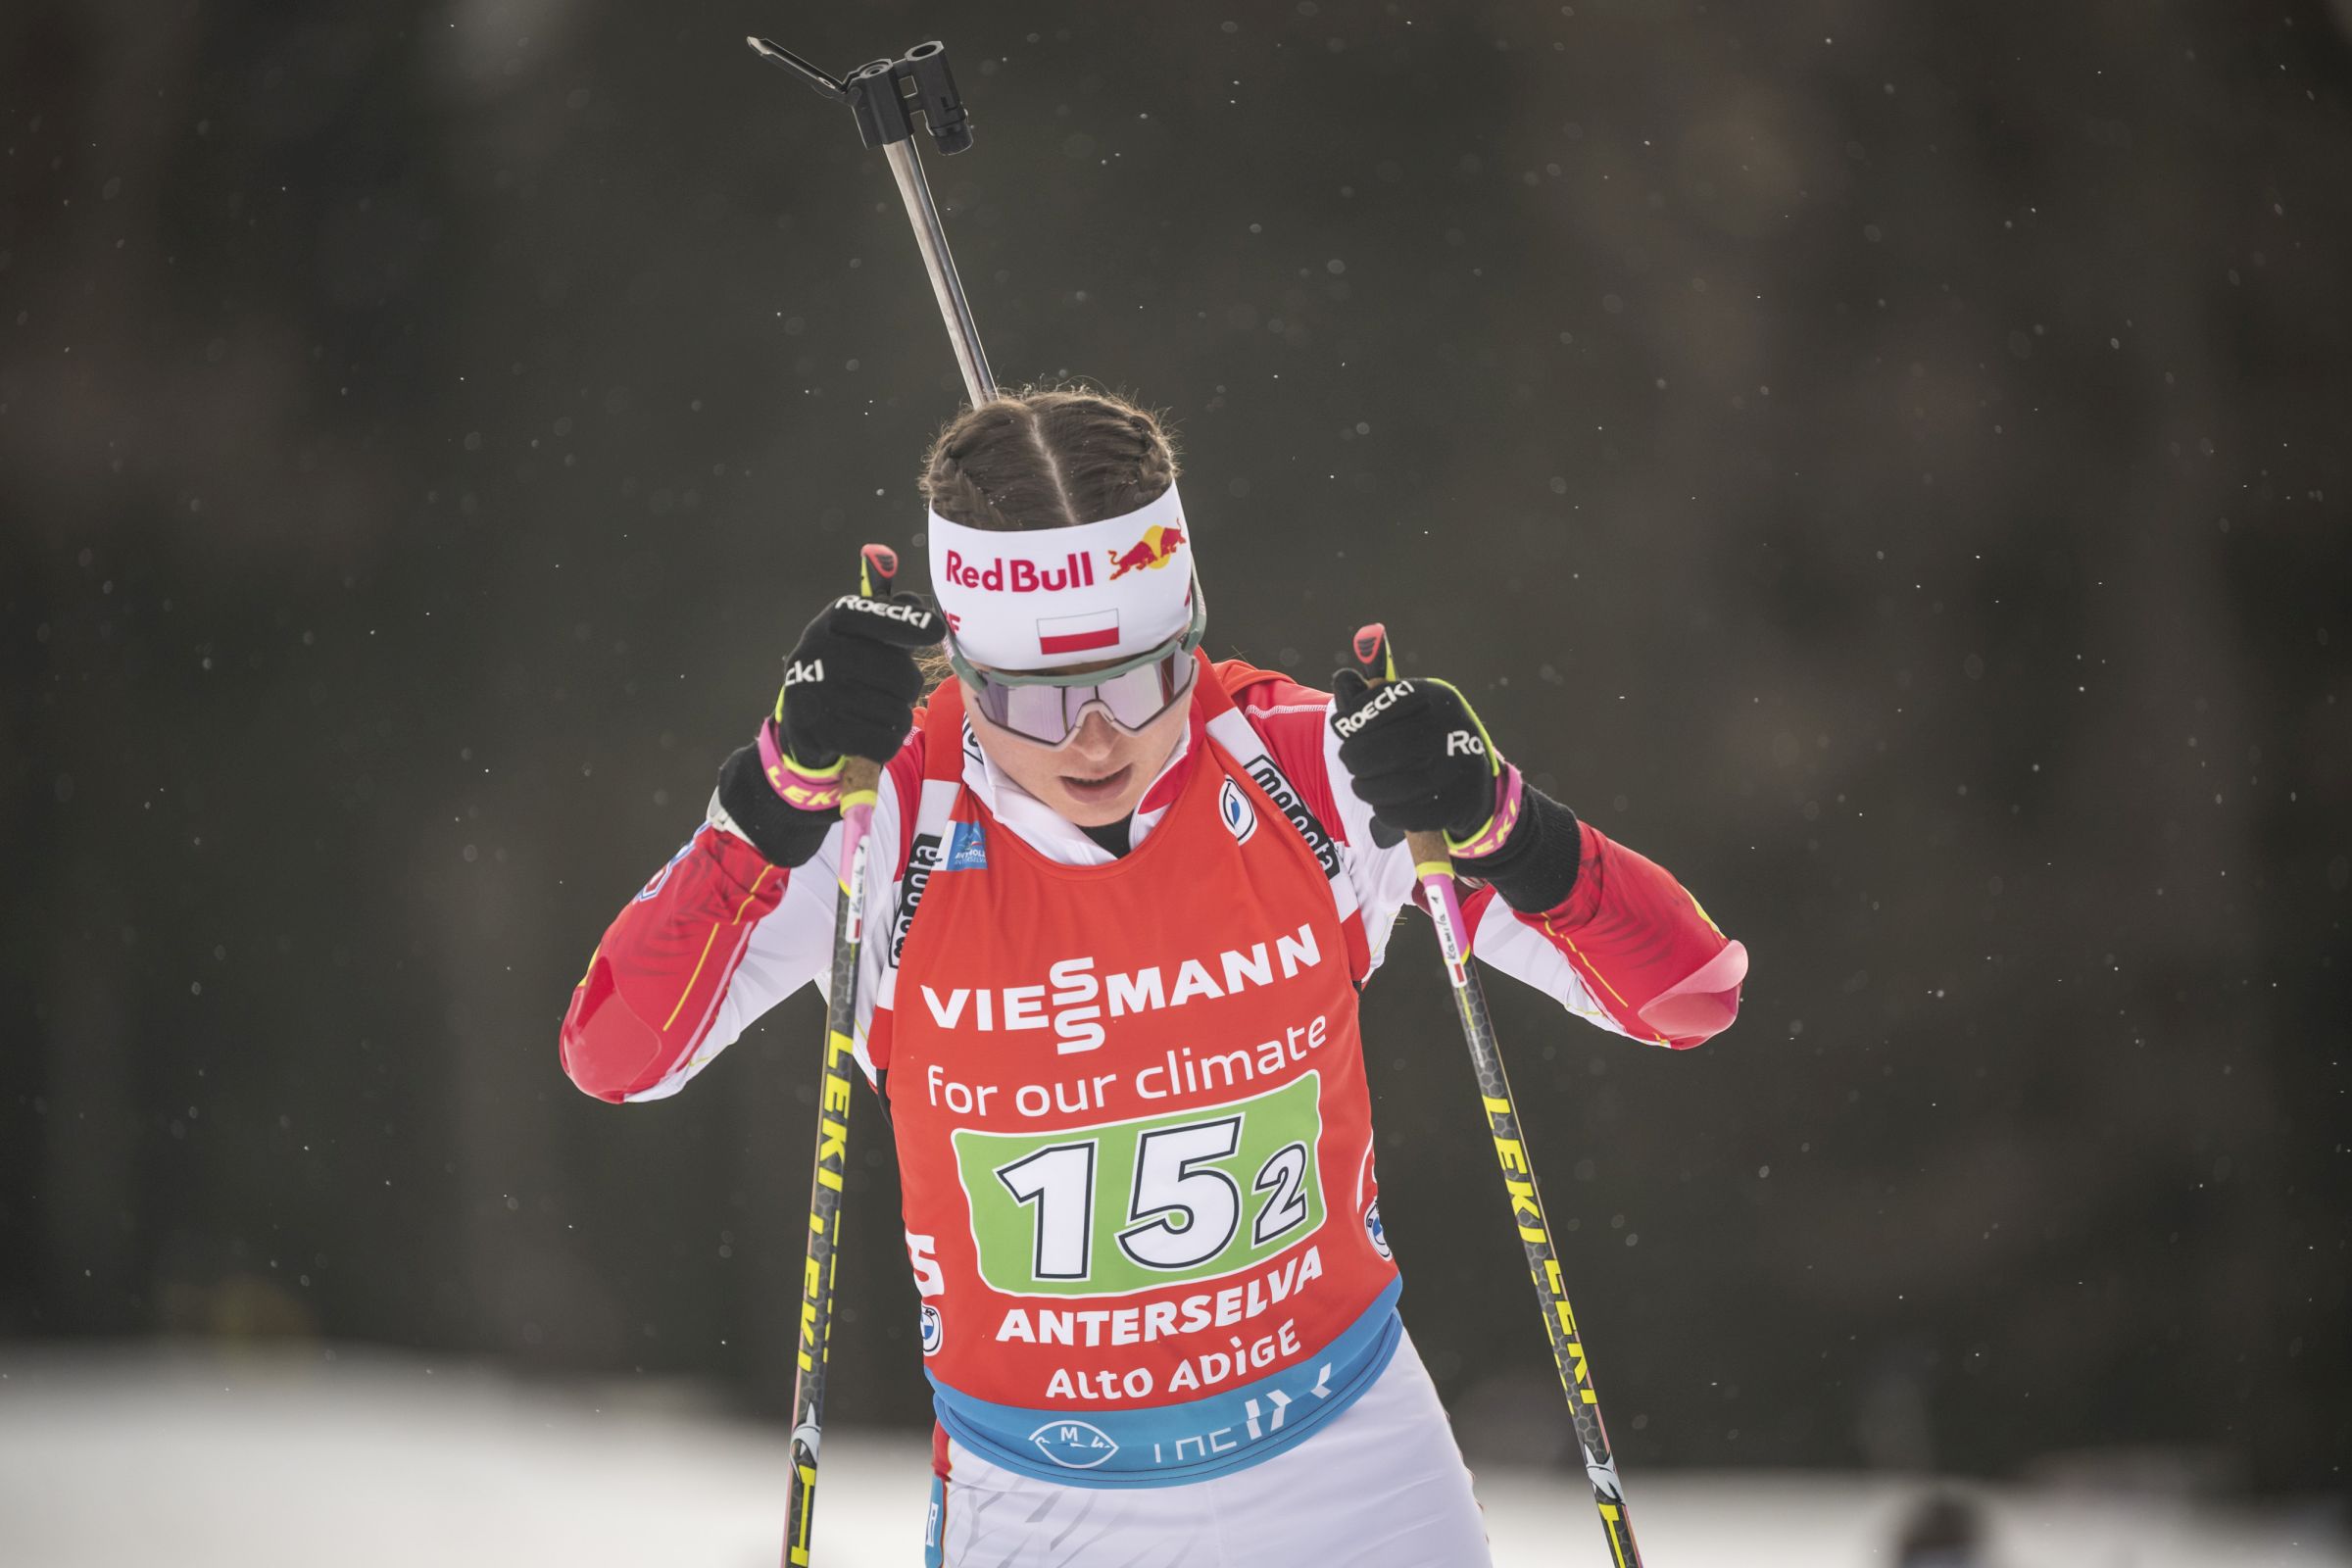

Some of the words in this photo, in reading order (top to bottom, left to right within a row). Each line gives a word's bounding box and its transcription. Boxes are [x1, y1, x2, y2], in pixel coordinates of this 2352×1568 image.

[947, 549, 1004, 592] Red
[1009, 551, 1095, 593] Bull
[920, 923, 1321, 1054] VIESSMANN
[817, 1030, 854, 1192] LEKI
[927, 1064, 998, 1116] for
[1015, 1073, 1116, 1116] our
[1135, 1014, 1327, 1100] climate
[993, 1112, 1247, 1282] 15
[1251, 1140, 1307, 1250] 2
[1482, 1095, 1546, 1243] LEKI
[995, 1245, 1323, 1347] ANTERSELVA
